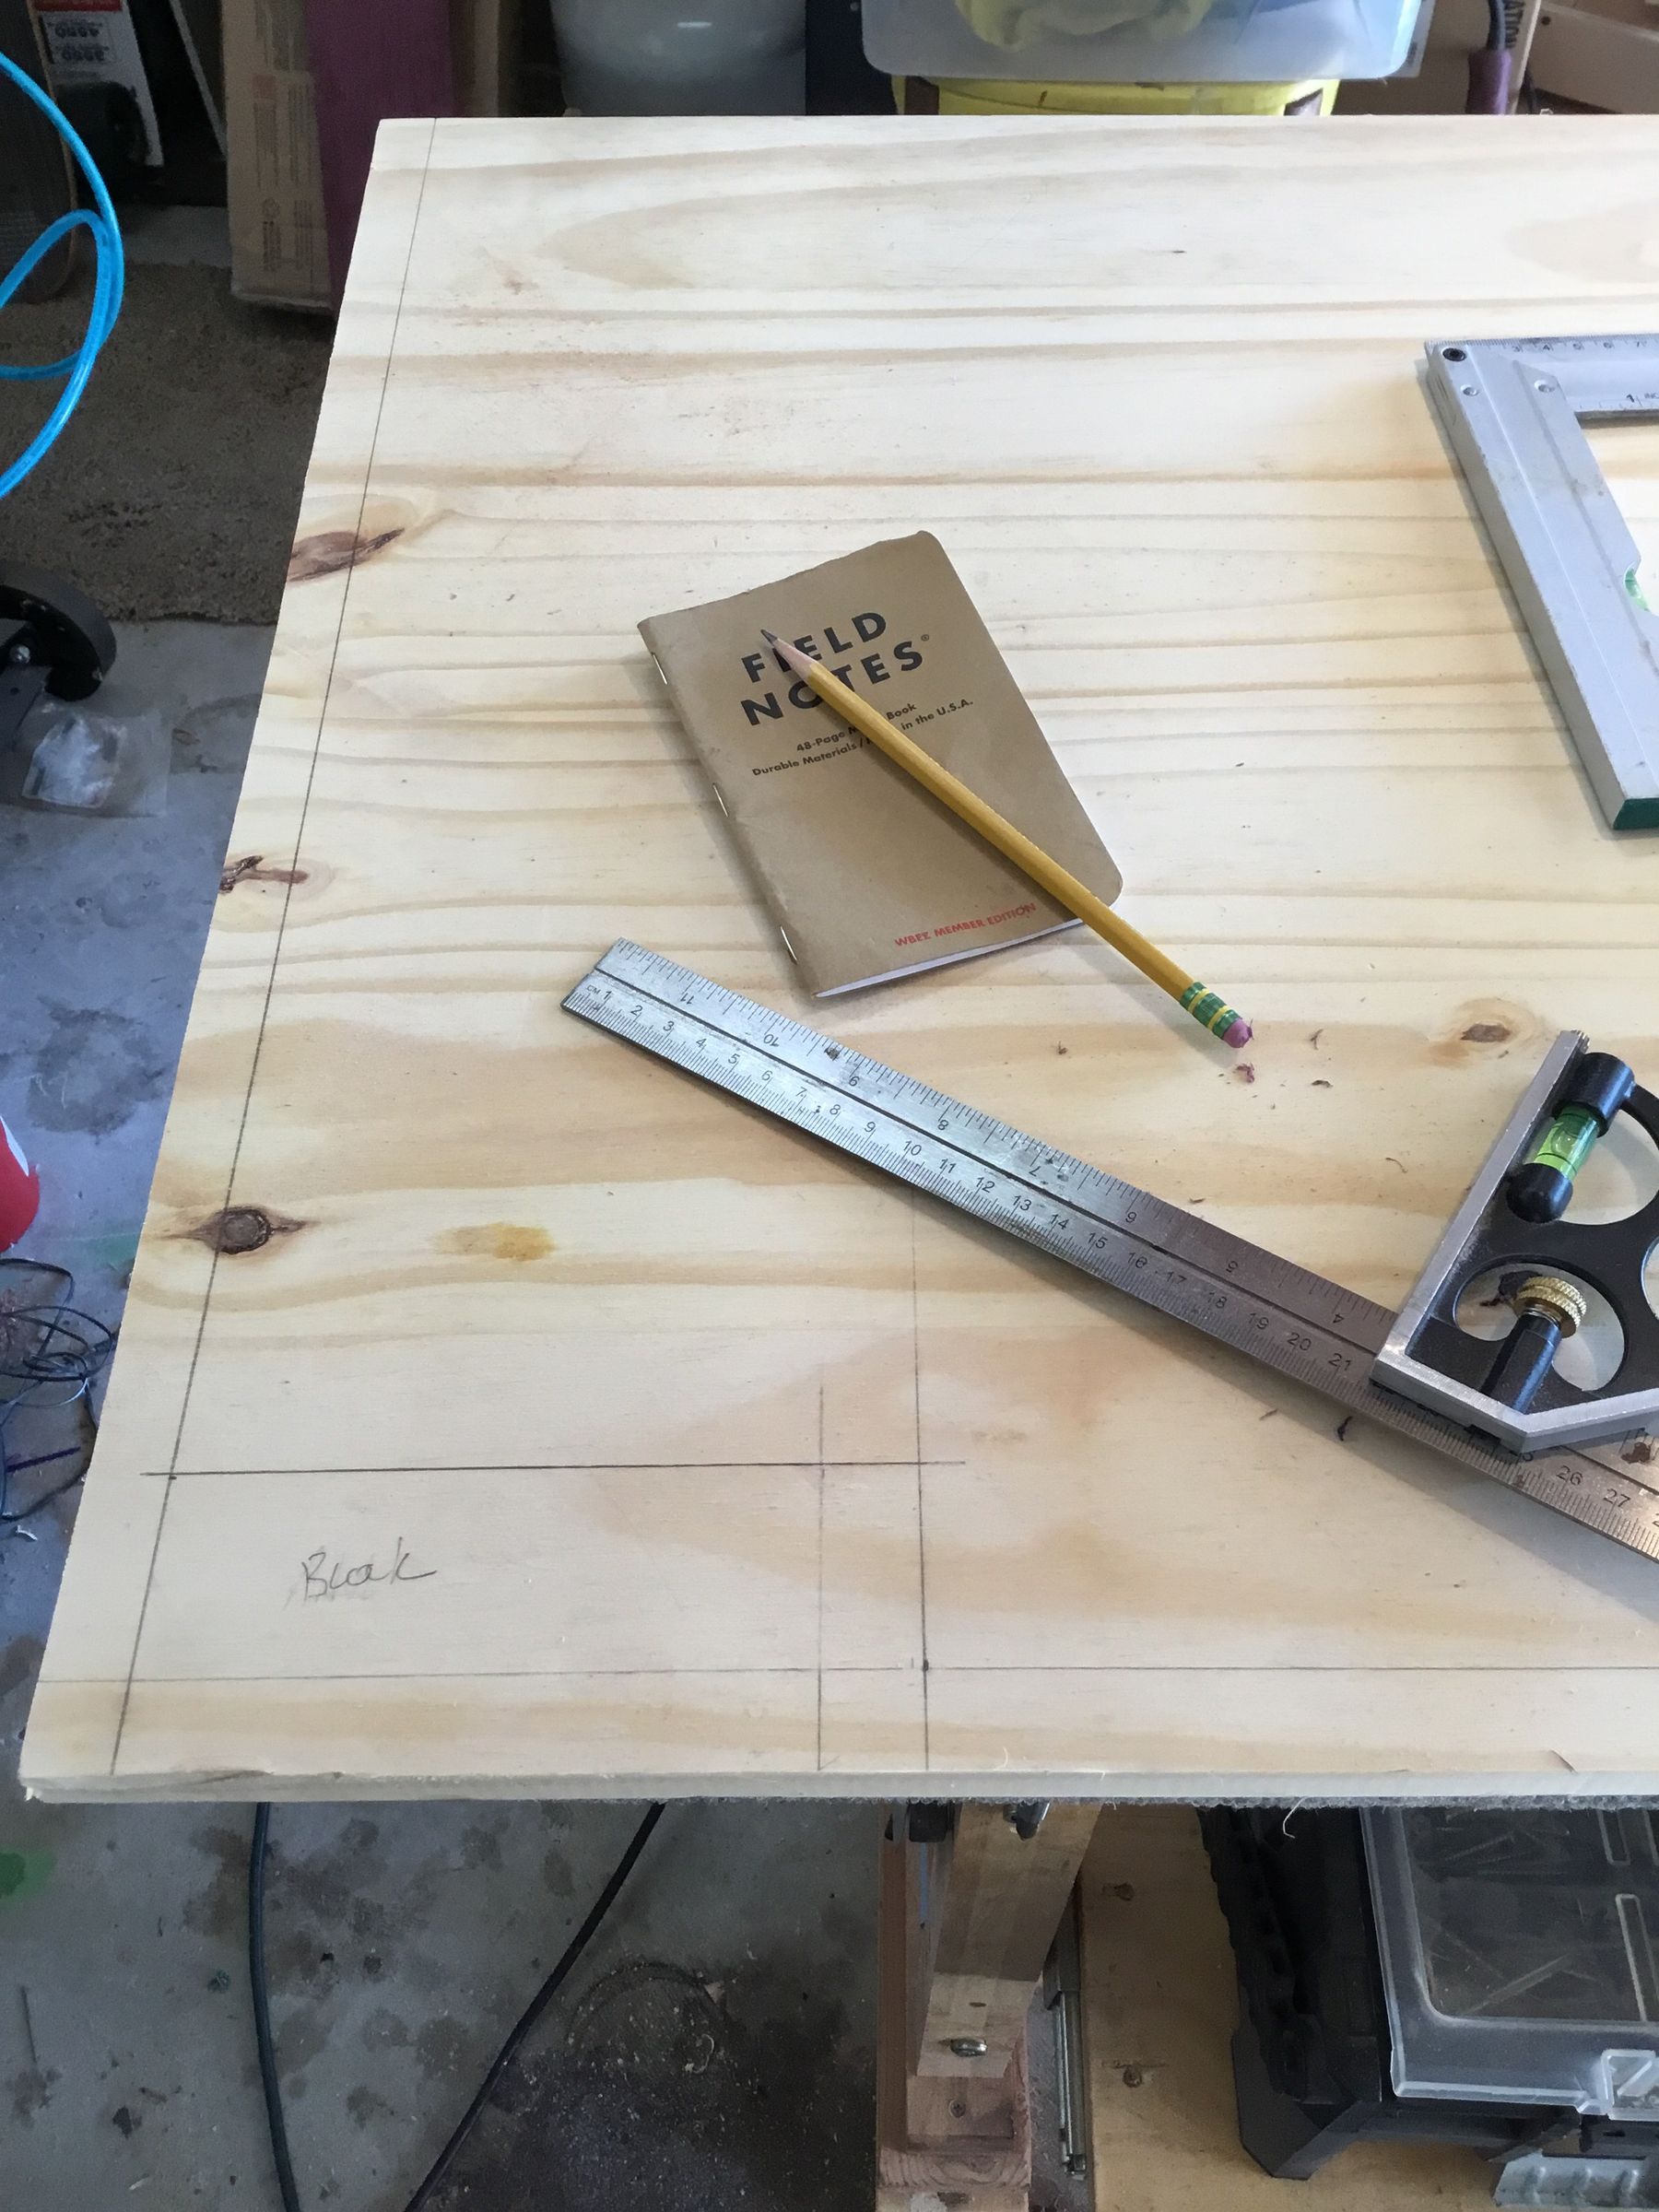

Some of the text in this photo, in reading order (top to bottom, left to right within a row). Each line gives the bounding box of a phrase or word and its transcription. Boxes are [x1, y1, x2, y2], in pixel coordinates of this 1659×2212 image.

[752, 760, 800, 775] Durable
[803, 743, 857, 765] Materials
[901, 722, 913, 731] in
[915, 712, 935, 725] the
[935, 699, 974, 716] U.S.A.
[796, 731, 846, 752] 48-Page
[886, 703, 917, 721] Book
[934, 919, 985, 937] MEMBER
[987, 902, 1037, 925] EDITION
[937, 1119, 949, 1131] 8
[630, 1005, 643, 1016] 2
[663, 1020, 675, 1032] 3
[695, 1038, 707, 1048] 4
[728, 1053, 740, 1065] 5
[761, 1070, 772, 1081] 6
[795, 1087, 806, 1097] 7
[830, 1104, 841, 1115] 8
[865, 1121, 876, 1133] 9
[904, 1140, 922, 1156] 10
[939, 1159, 957, 1174] 11
[975, 1177, 995, 1194] 12
[1012, 1195, 1032, 1211] 13
[1050, 1213, 1070, 1230] 14
[1088, 1232, 1109, 1249] 15
[1127, 1252, 1148, 1269] 16
[1166, 1271, 1187, 1285] 17
[1208, 1292, 1228, 1310] 18
[1248, 1312, 1270, 1330] 19
[1287, 1332, 1312, 1351] 20
[1327, 1352, 1352, 1371] 21
[1555, 1465, 1583, 1486] 26
[1603, 1488, 1631, 1508] 27
